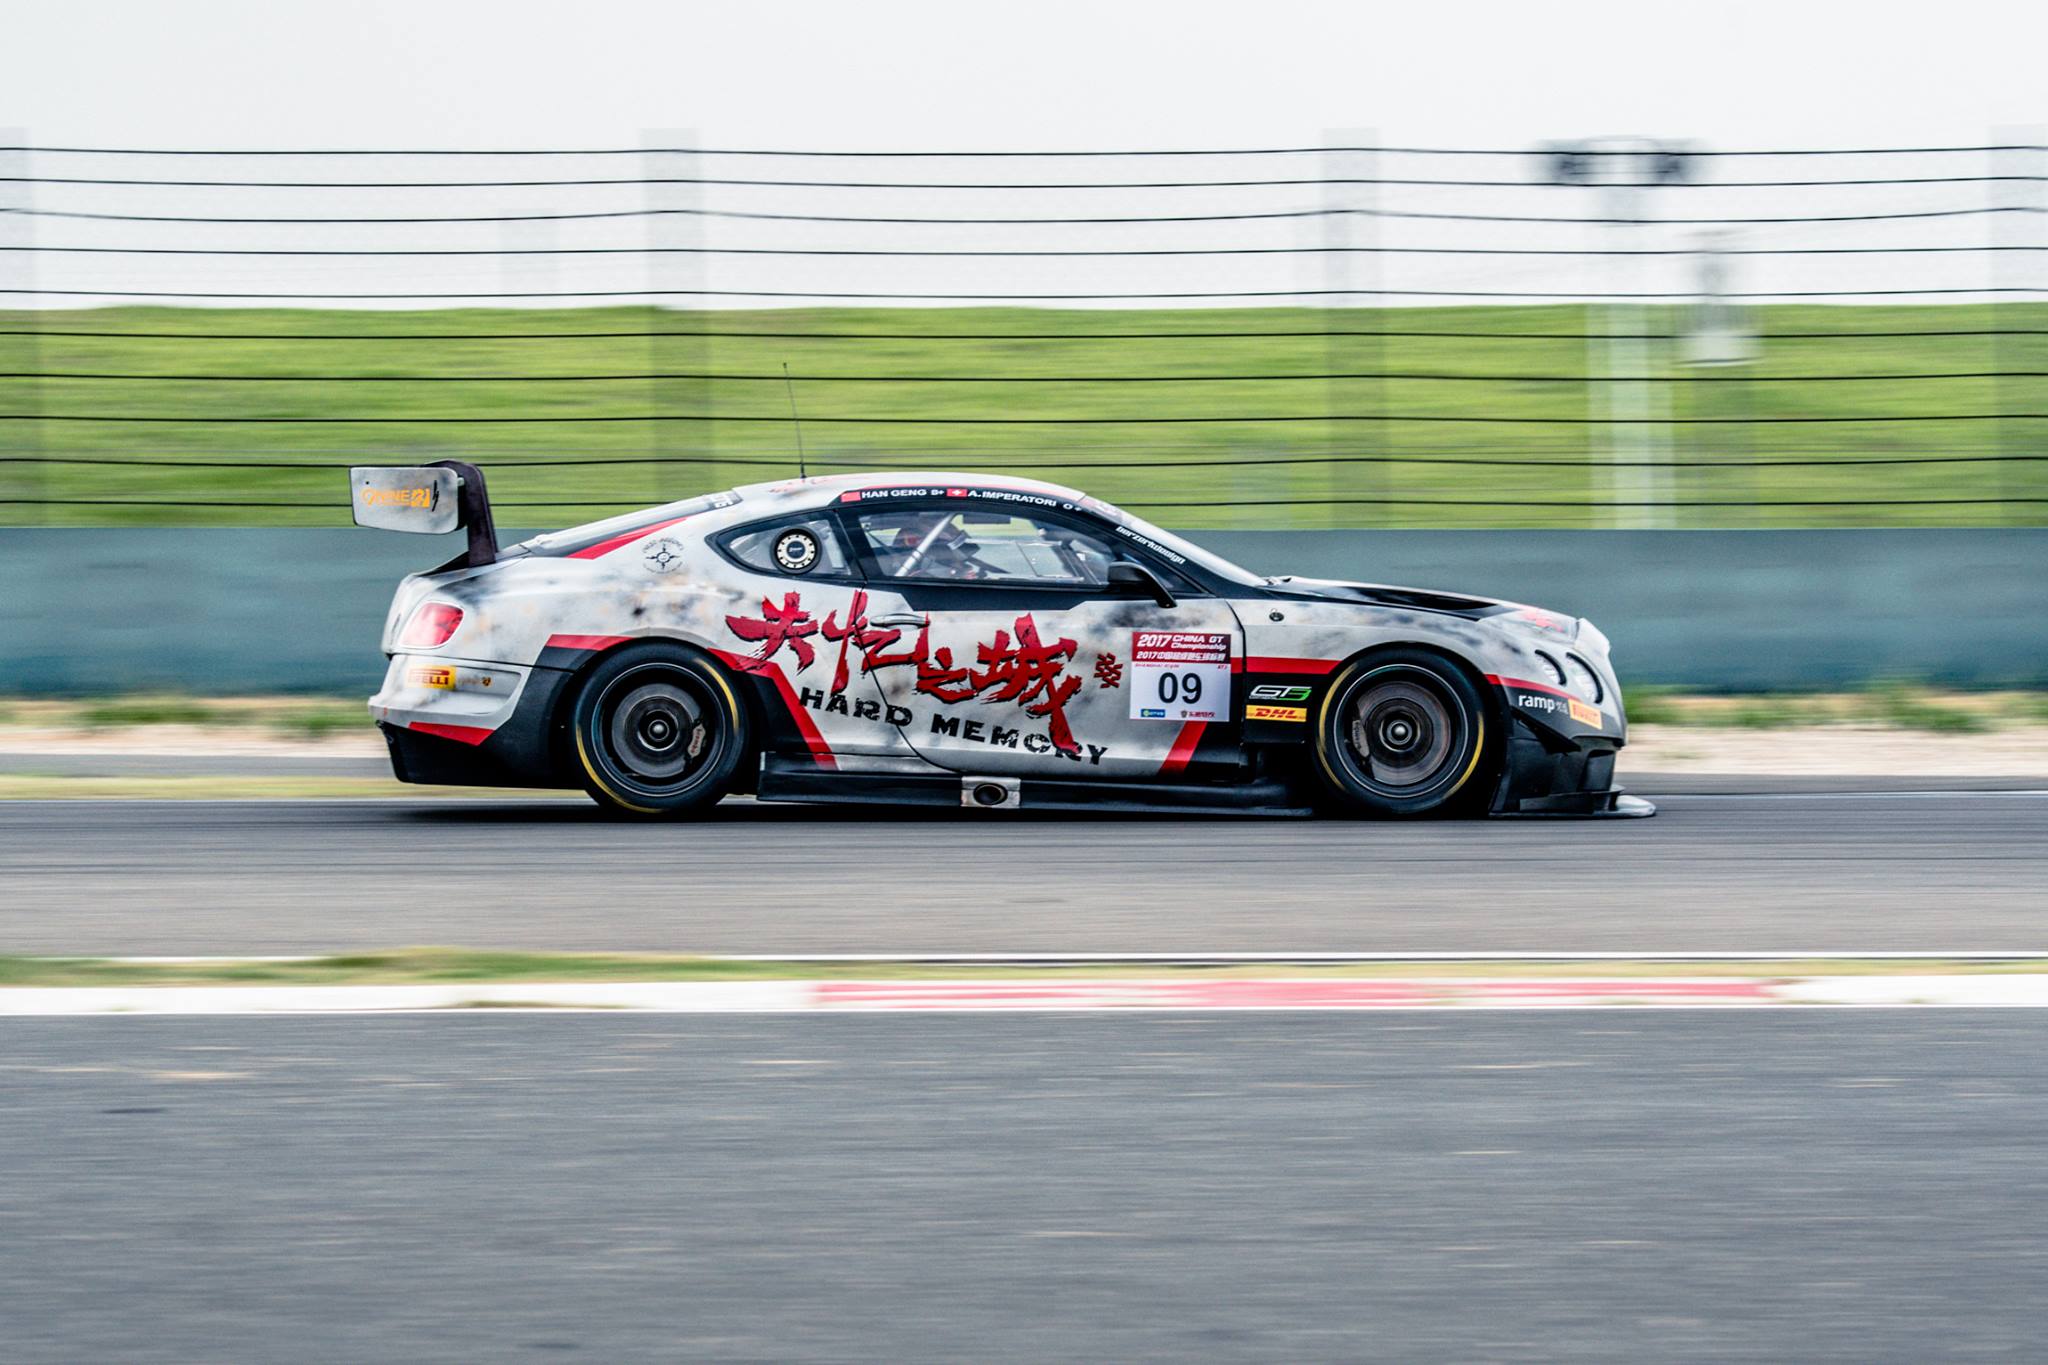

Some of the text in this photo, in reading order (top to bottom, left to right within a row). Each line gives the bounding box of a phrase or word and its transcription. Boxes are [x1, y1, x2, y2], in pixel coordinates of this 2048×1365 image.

[861, 490, 889, 499] HAN
[890, 488, 927, 497] GENG
[967, 490, 1057, 508] A.IMPERATORI
[1137, 634, 1172, 648] 2017
[1172, 635, 1205, 643] CHINA
[1171, 643, 1227, 651] Championship
[1158, 672, 1203, 704] 09
[800, 686, 912, 727] HARD
[1518, 695, 1555, 713] ramp
[1255, 707, 1297, 719] DHL
